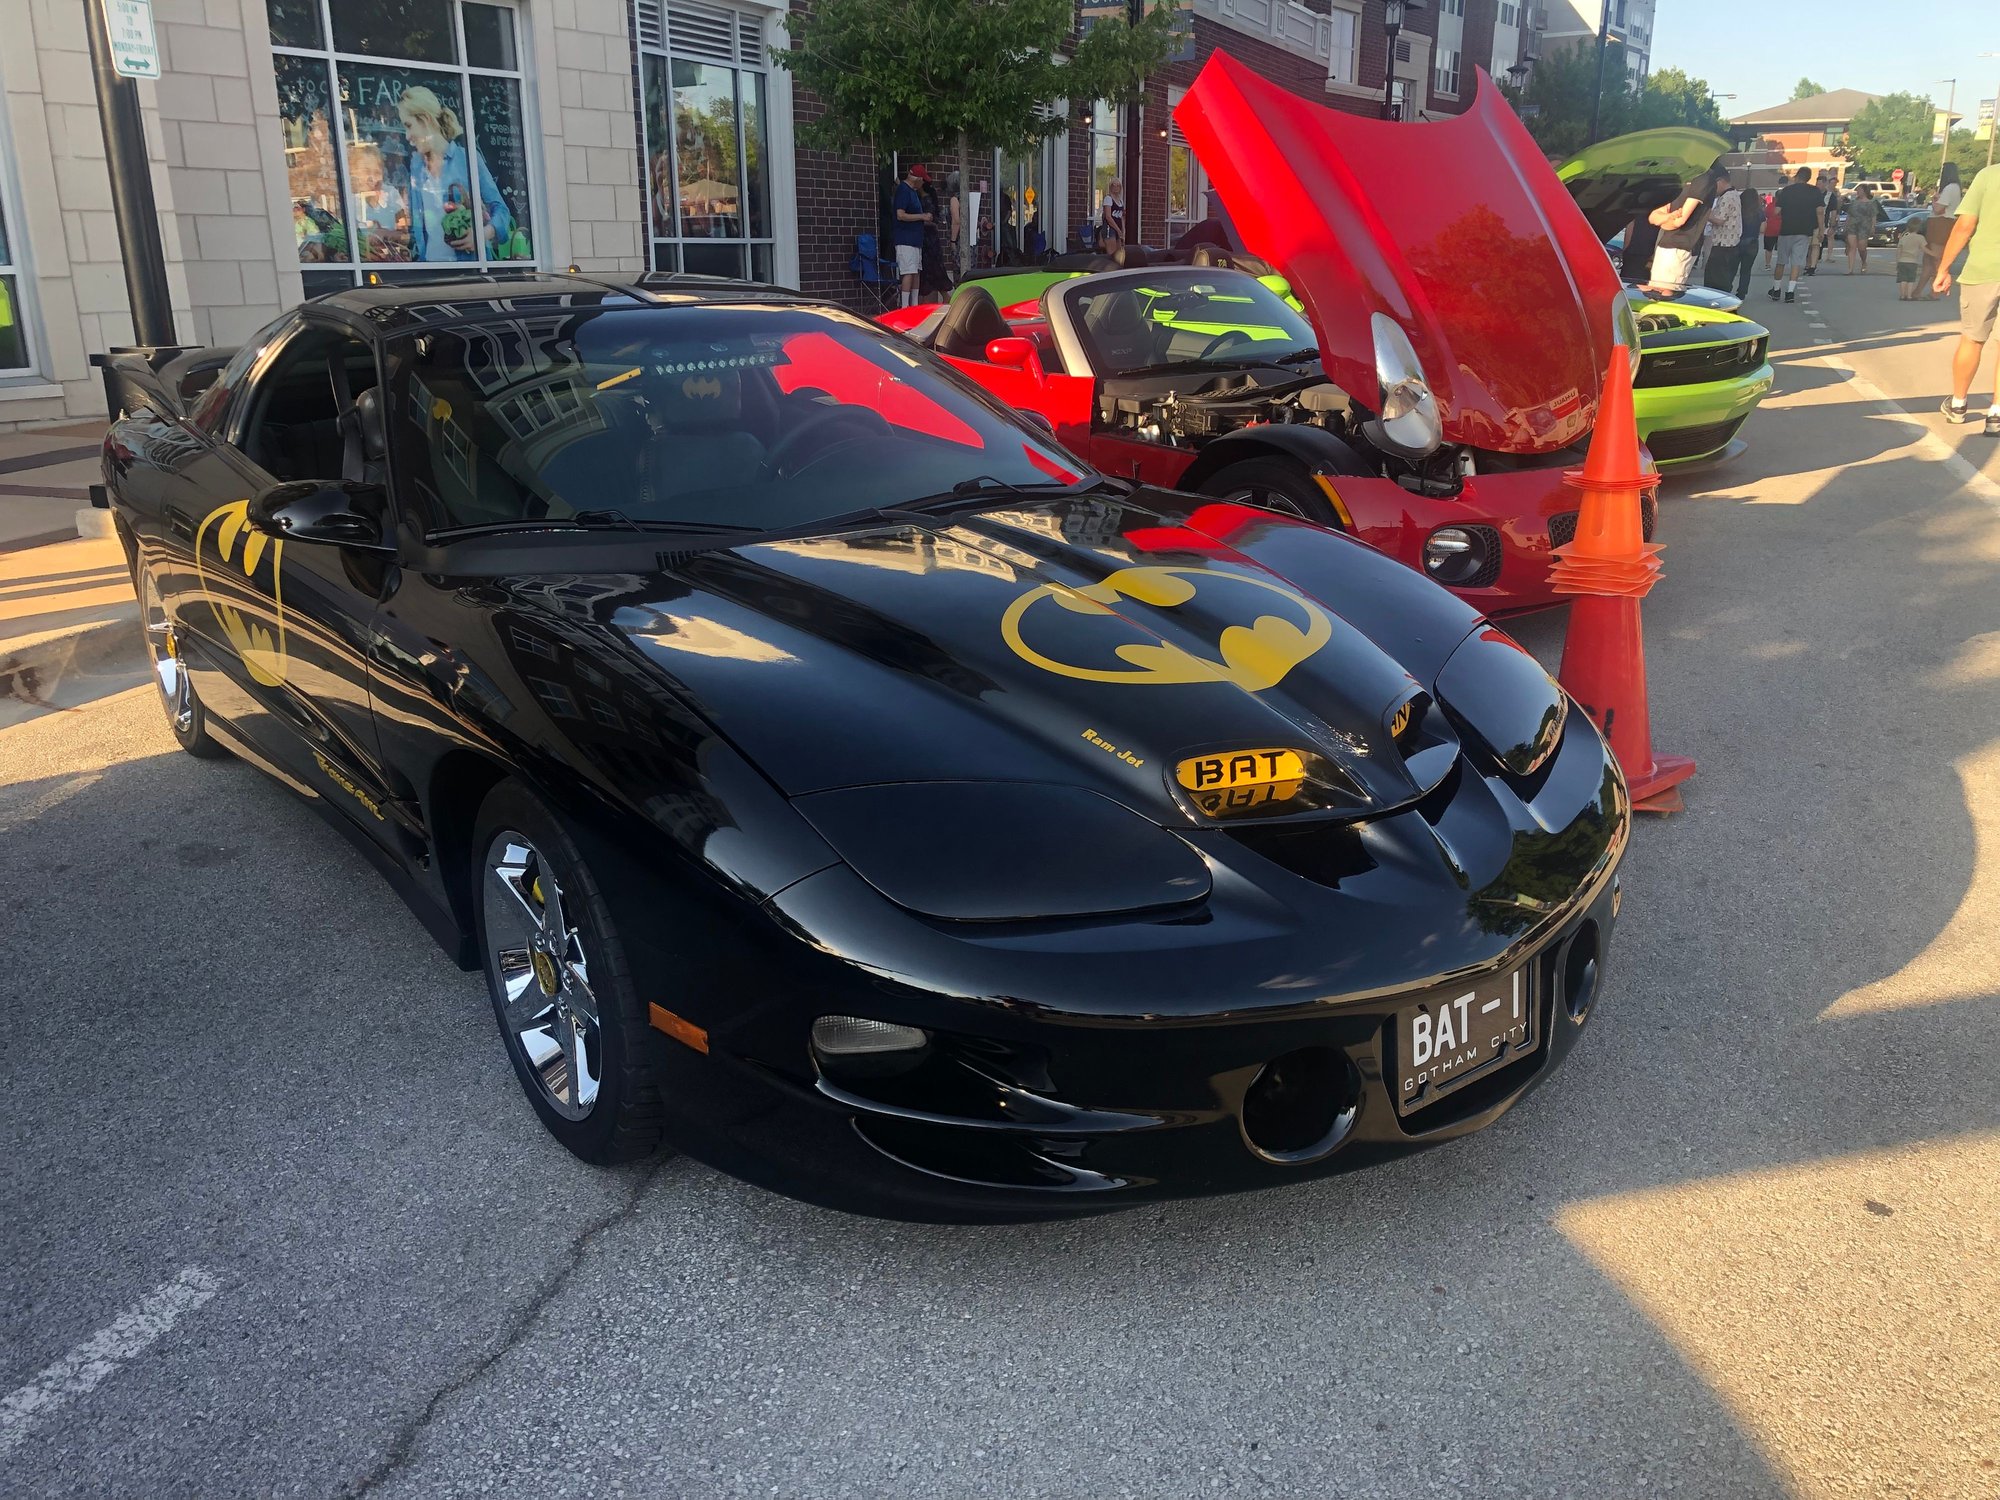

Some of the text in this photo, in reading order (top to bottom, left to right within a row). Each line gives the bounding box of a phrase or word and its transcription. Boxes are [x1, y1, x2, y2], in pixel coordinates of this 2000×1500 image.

[358, 76, 411, 107] FAR
[1081, 728, 1145, 769] Ram Jet
[1196, 751, 1287, 789] BAT
[1404, 1021, 1527, 1091] GOTHAM CITY
